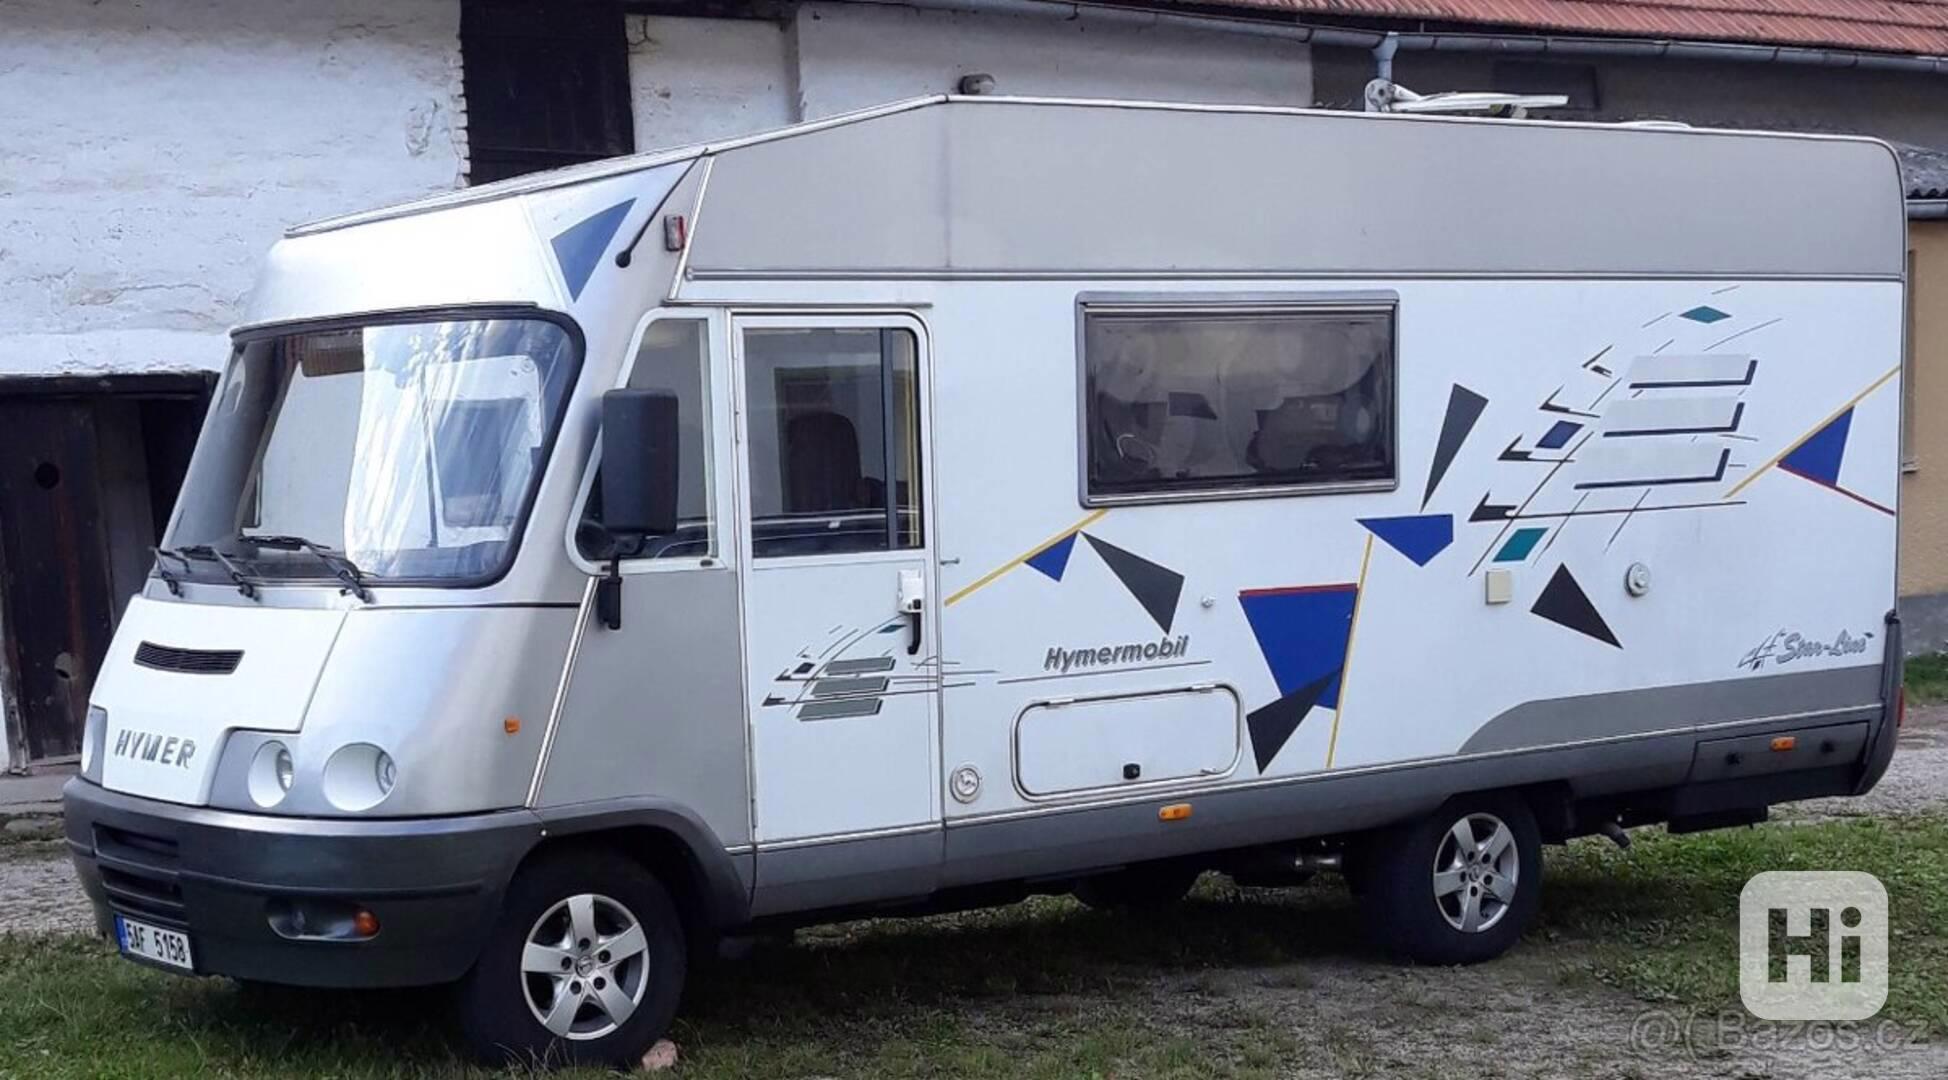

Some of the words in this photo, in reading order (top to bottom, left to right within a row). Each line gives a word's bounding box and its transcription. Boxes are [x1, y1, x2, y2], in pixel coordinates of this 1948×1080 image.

[1044, 634, 1190, 673] Hymermobil
[114, 728, 196, 769] HYMER
[126, 922, 144, 952] 5AF
[154, 930, 186, 963] 5158
